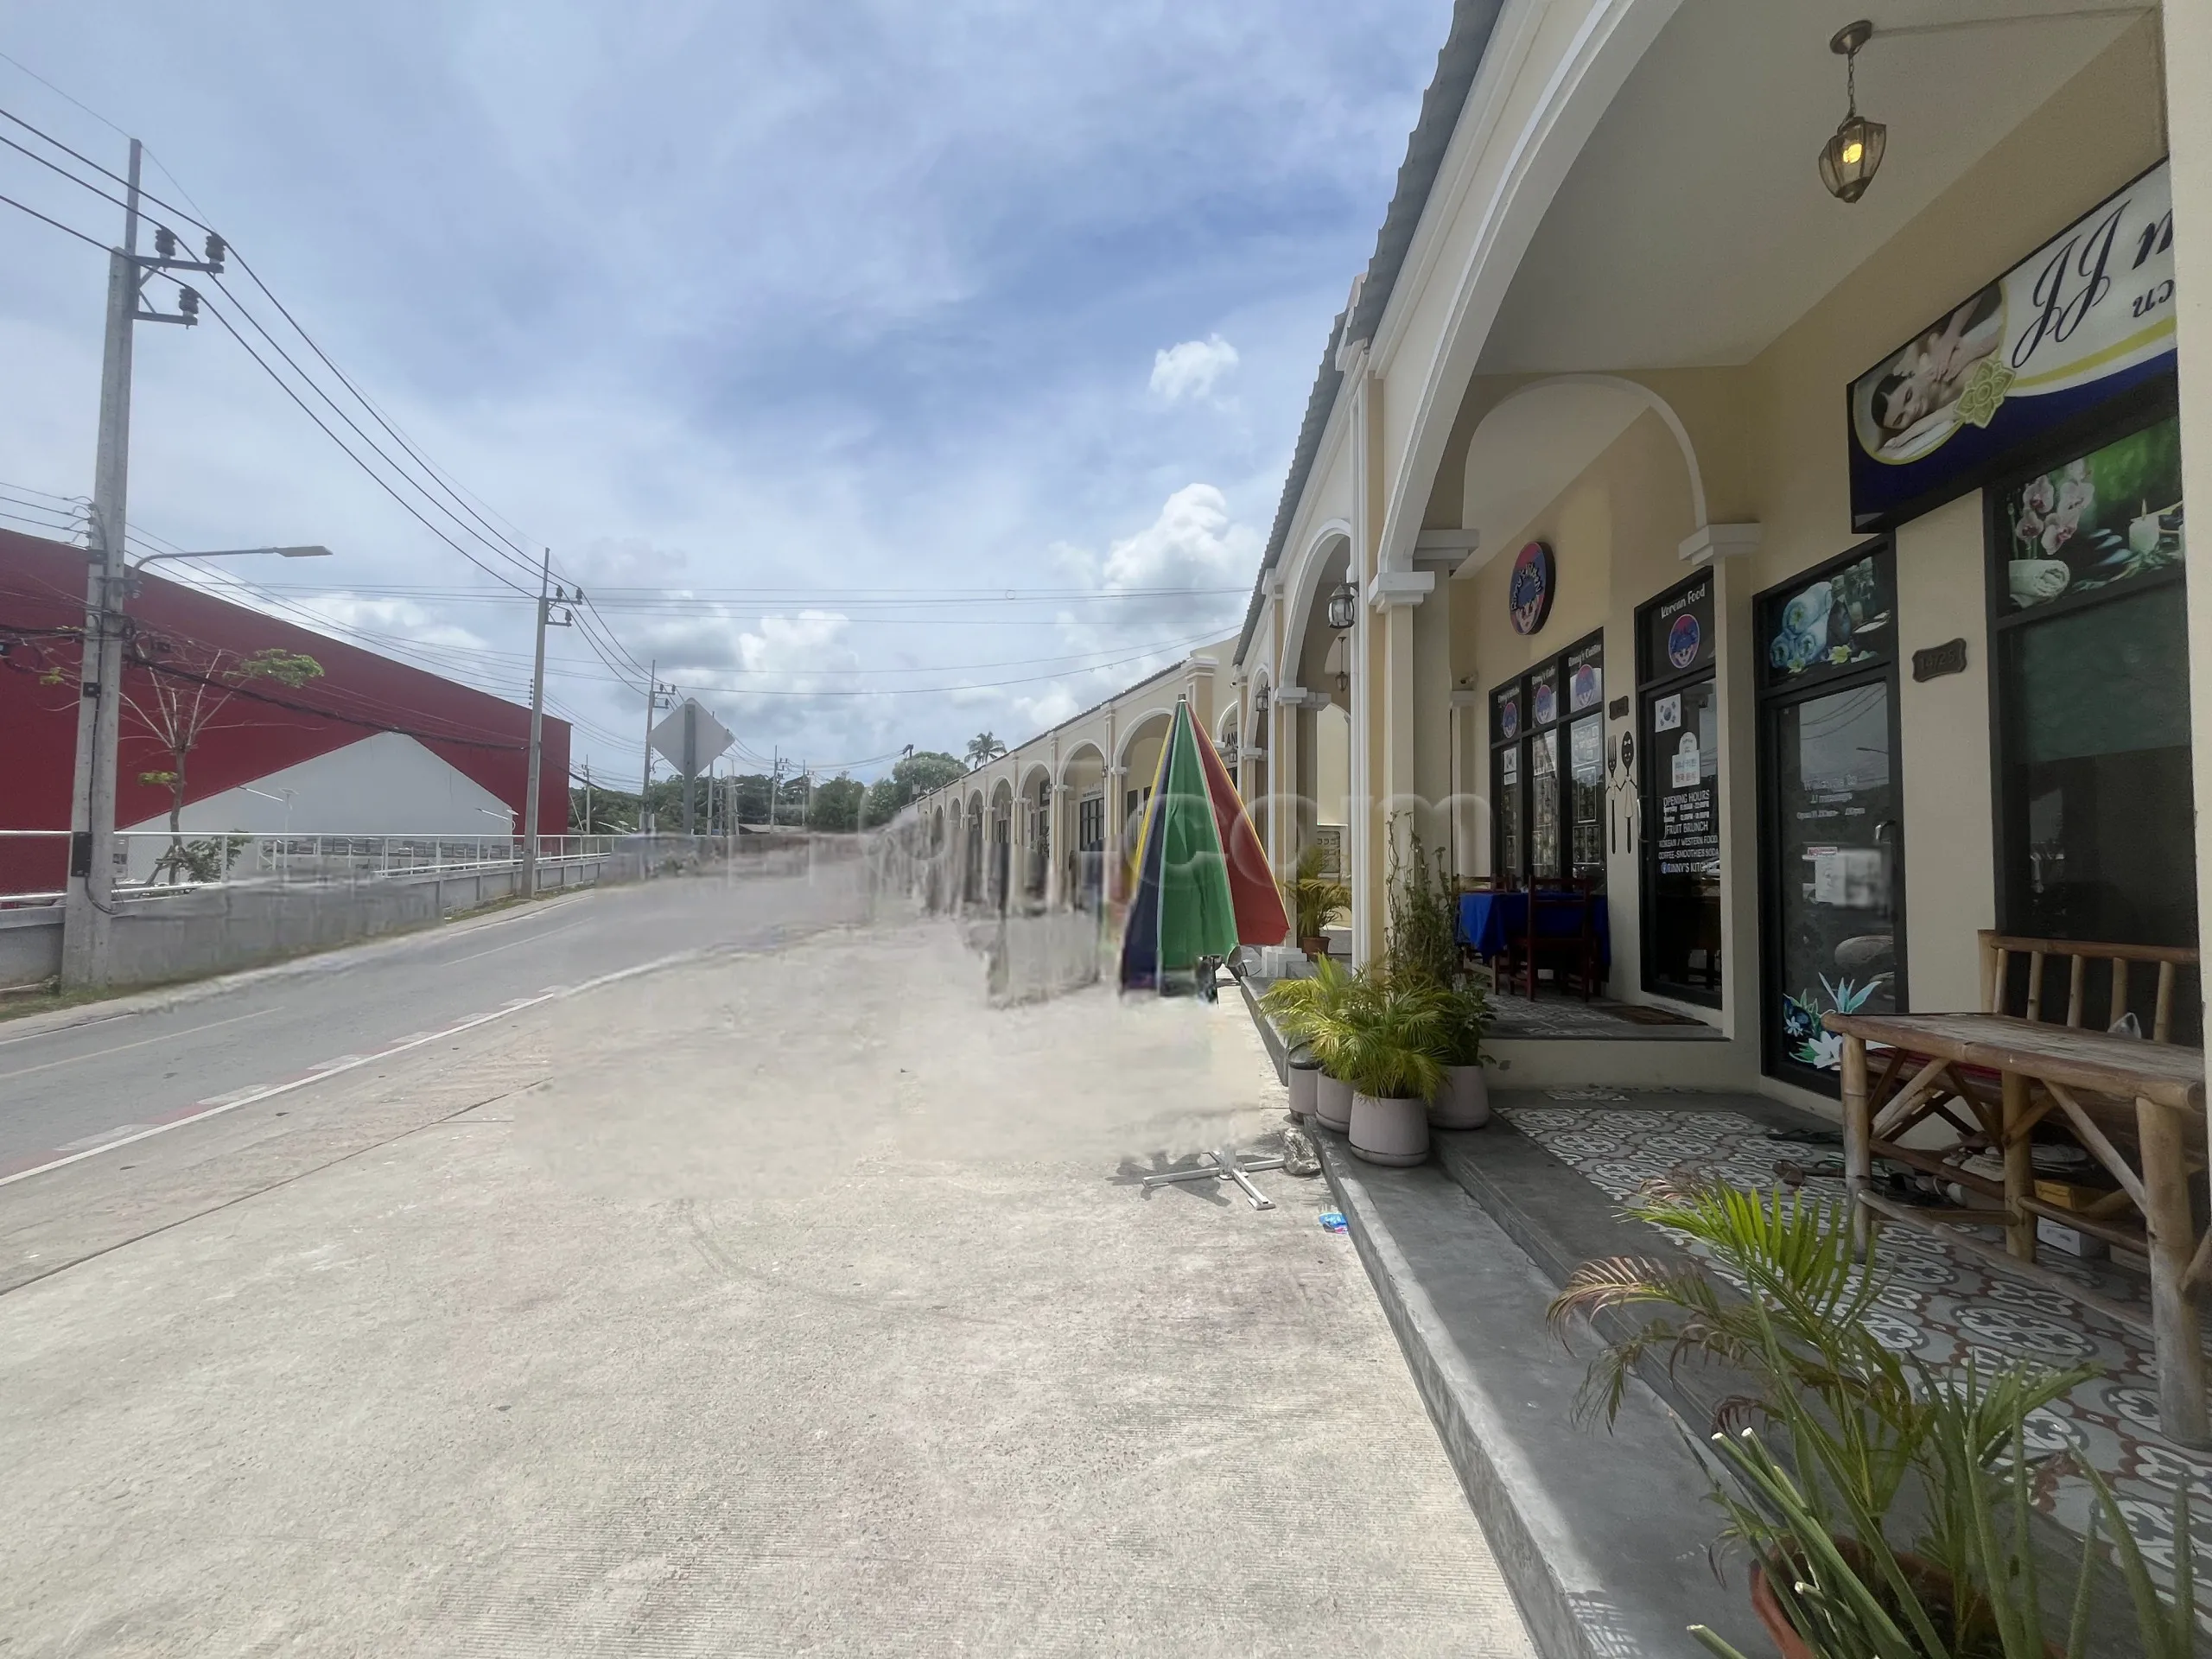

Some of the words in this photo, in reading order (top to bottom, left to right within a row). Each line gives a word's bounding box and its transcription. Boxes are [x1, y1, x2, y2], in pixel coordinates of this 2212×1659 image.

[2012, 198, 2133, 368] JJ
[1661, 598, 1686, 619] Korean
[1688, 582, 1705, 604] Food
[1663, 794, 1688, 808] OPENING
[1688, 790, 1710, 803] HOURS
[1666, 823, 1682, 836] FRUIT
[1682, 821, 1709, 834] BRUNCH
[1681, 836, 1704, 846] WESTERN
